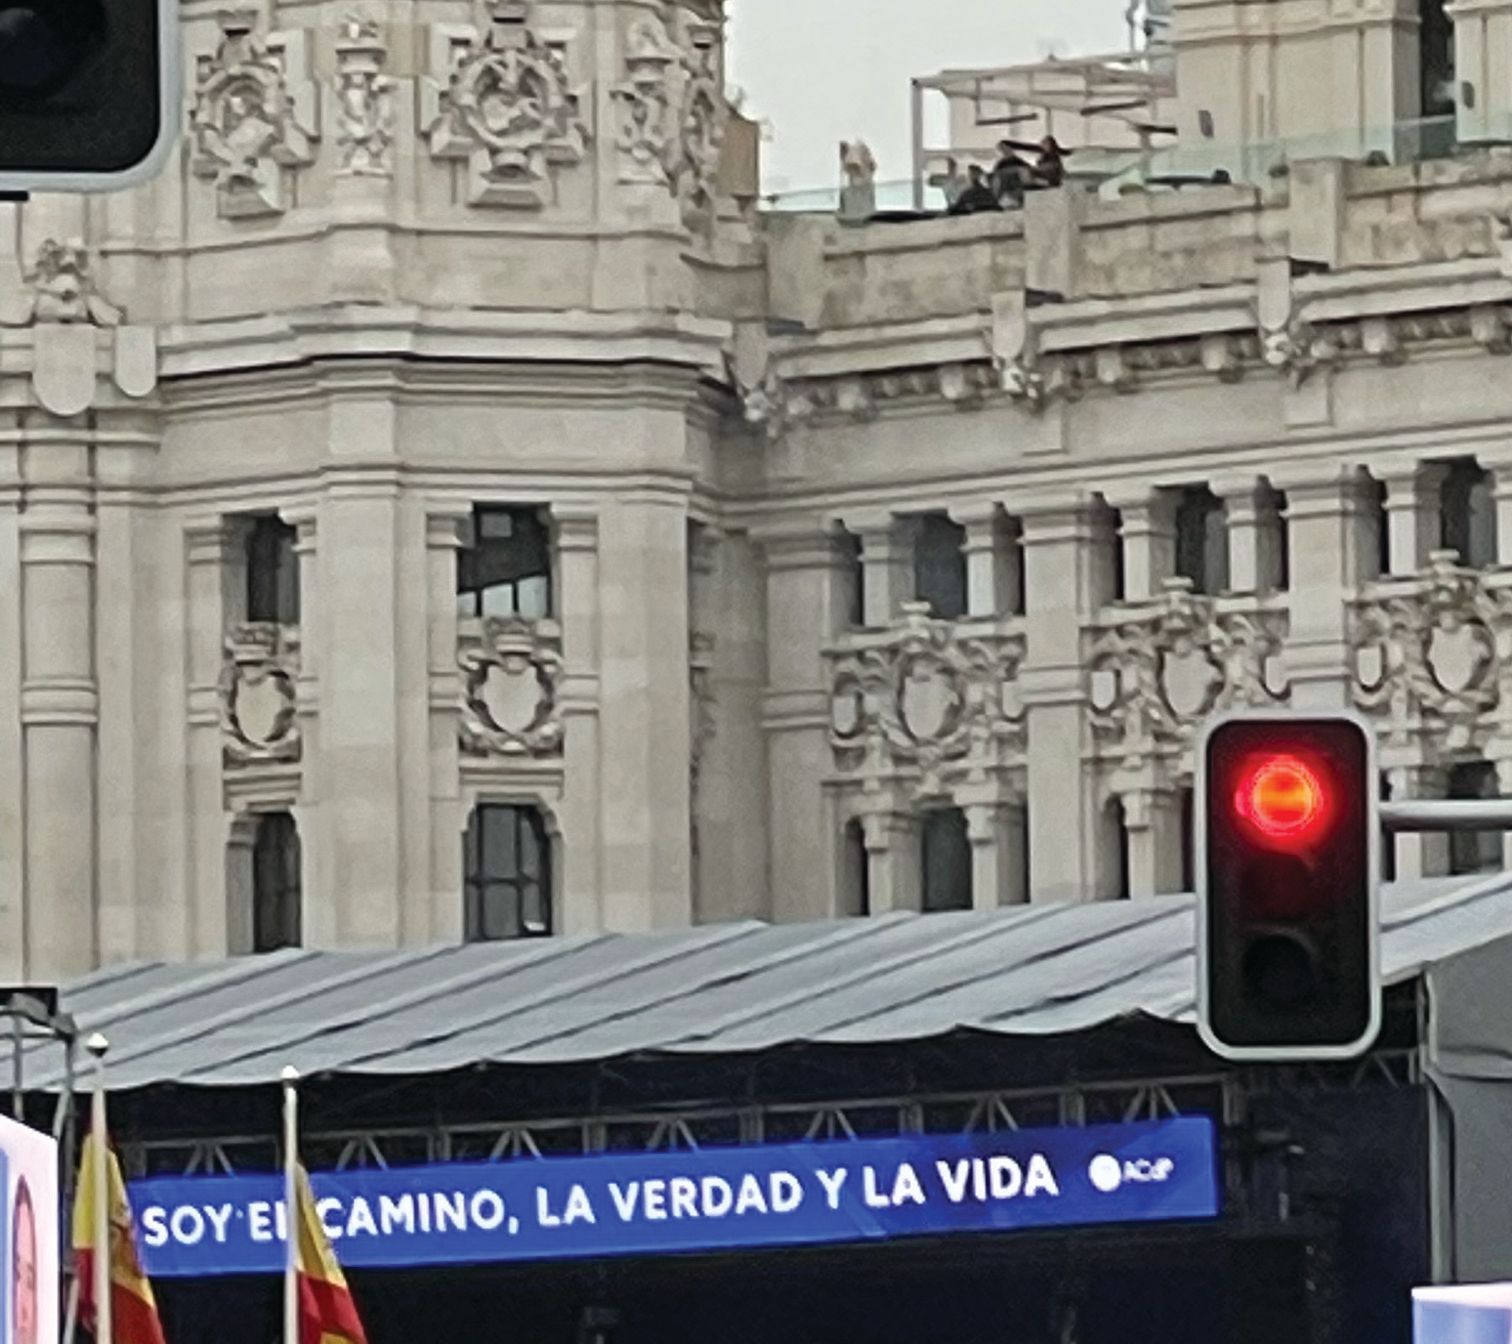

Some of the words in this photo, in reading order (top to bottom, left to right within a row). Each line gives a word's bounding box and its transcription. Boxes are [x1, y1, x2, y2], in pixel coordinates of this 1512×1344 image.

[142, 1203, 233, 1247] SOY
[316, 1189, 519, 1239] CAMINO,
[536, 1184, 596, 1227] LA
[607, 1170, 804, 1222] VERDAD
[814, 1167, 847, 1210] Y
[862, 1162, 926, 1207] LA
[935, 1152, 1060, 1203] VIDA
